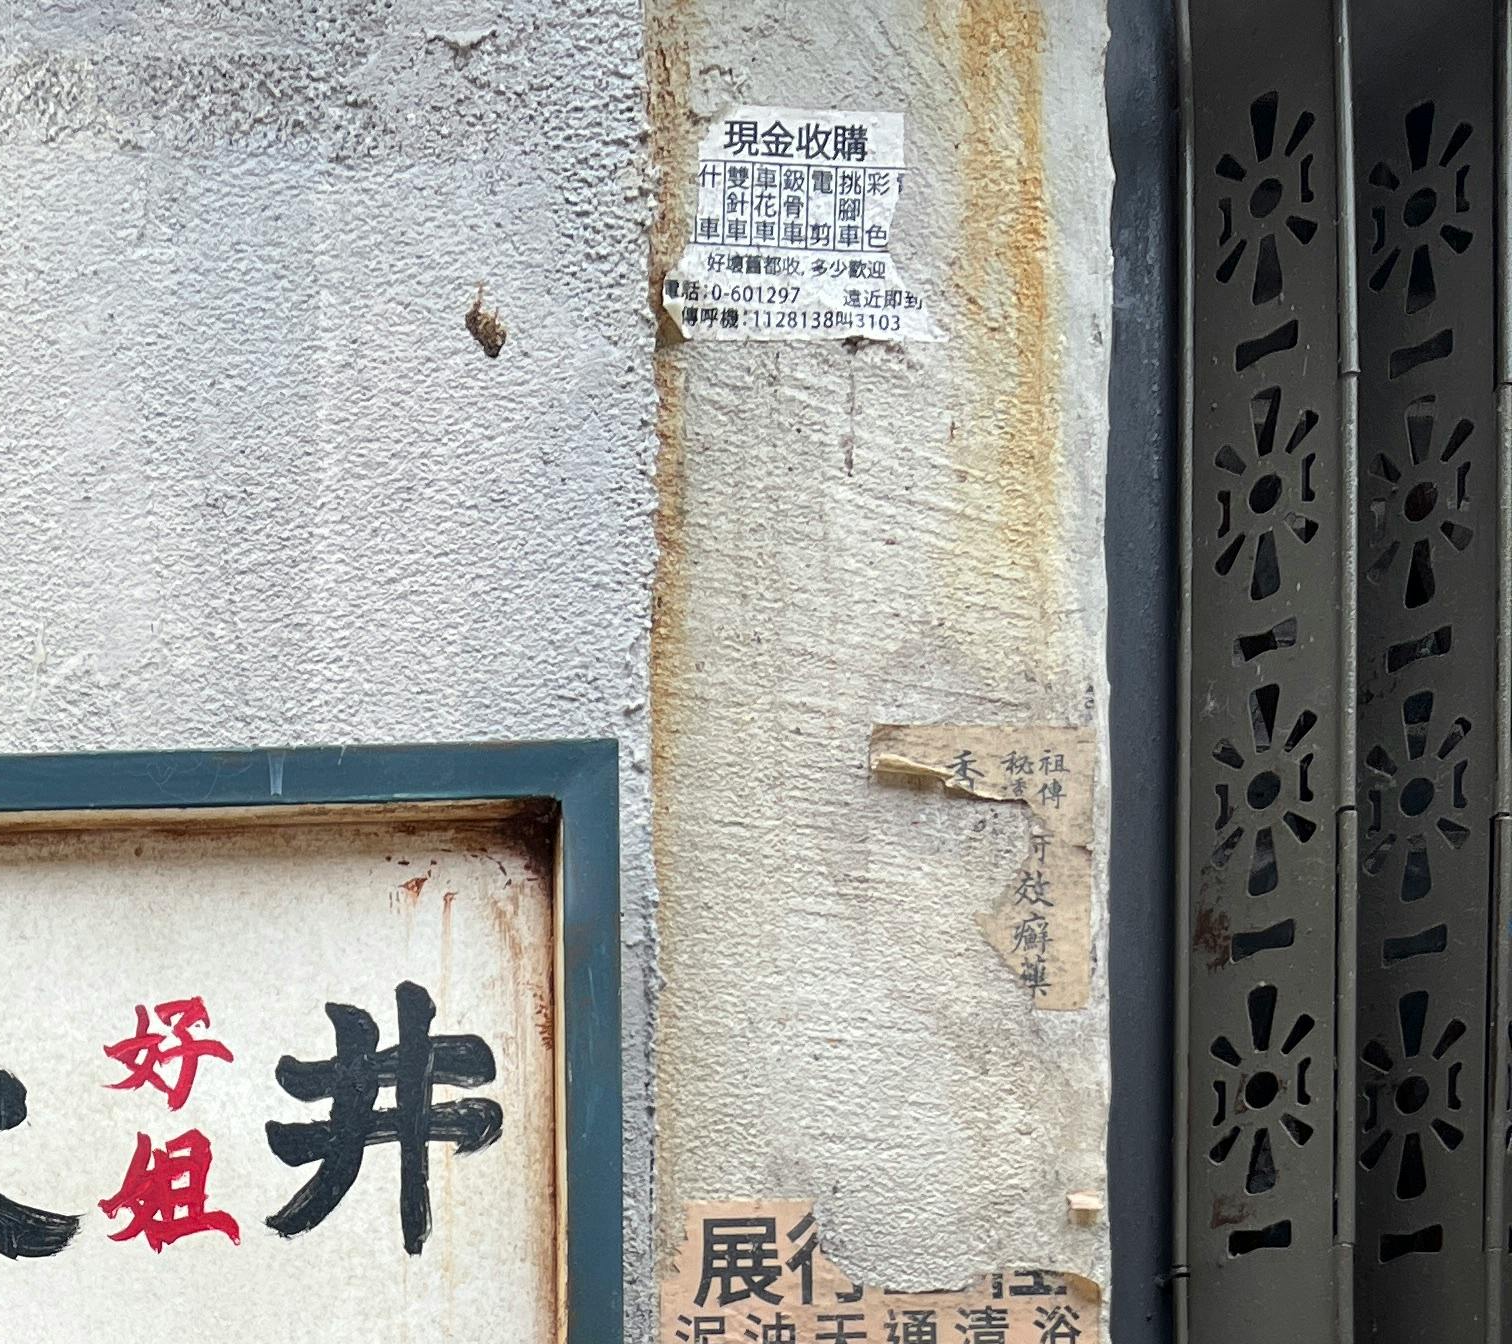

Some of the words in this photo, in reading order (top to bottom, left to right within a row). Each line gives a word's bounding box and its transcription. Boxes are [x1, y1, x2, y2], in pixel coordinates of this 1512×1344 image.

[724, 120, 868, 162] 現金收購
[726, 165, 750, 241] 雙針車
[754, 166, 778, 243] 車花車
[97, 996, 241, 1254] 好姐
[264, 981, 504, 1256] 井
